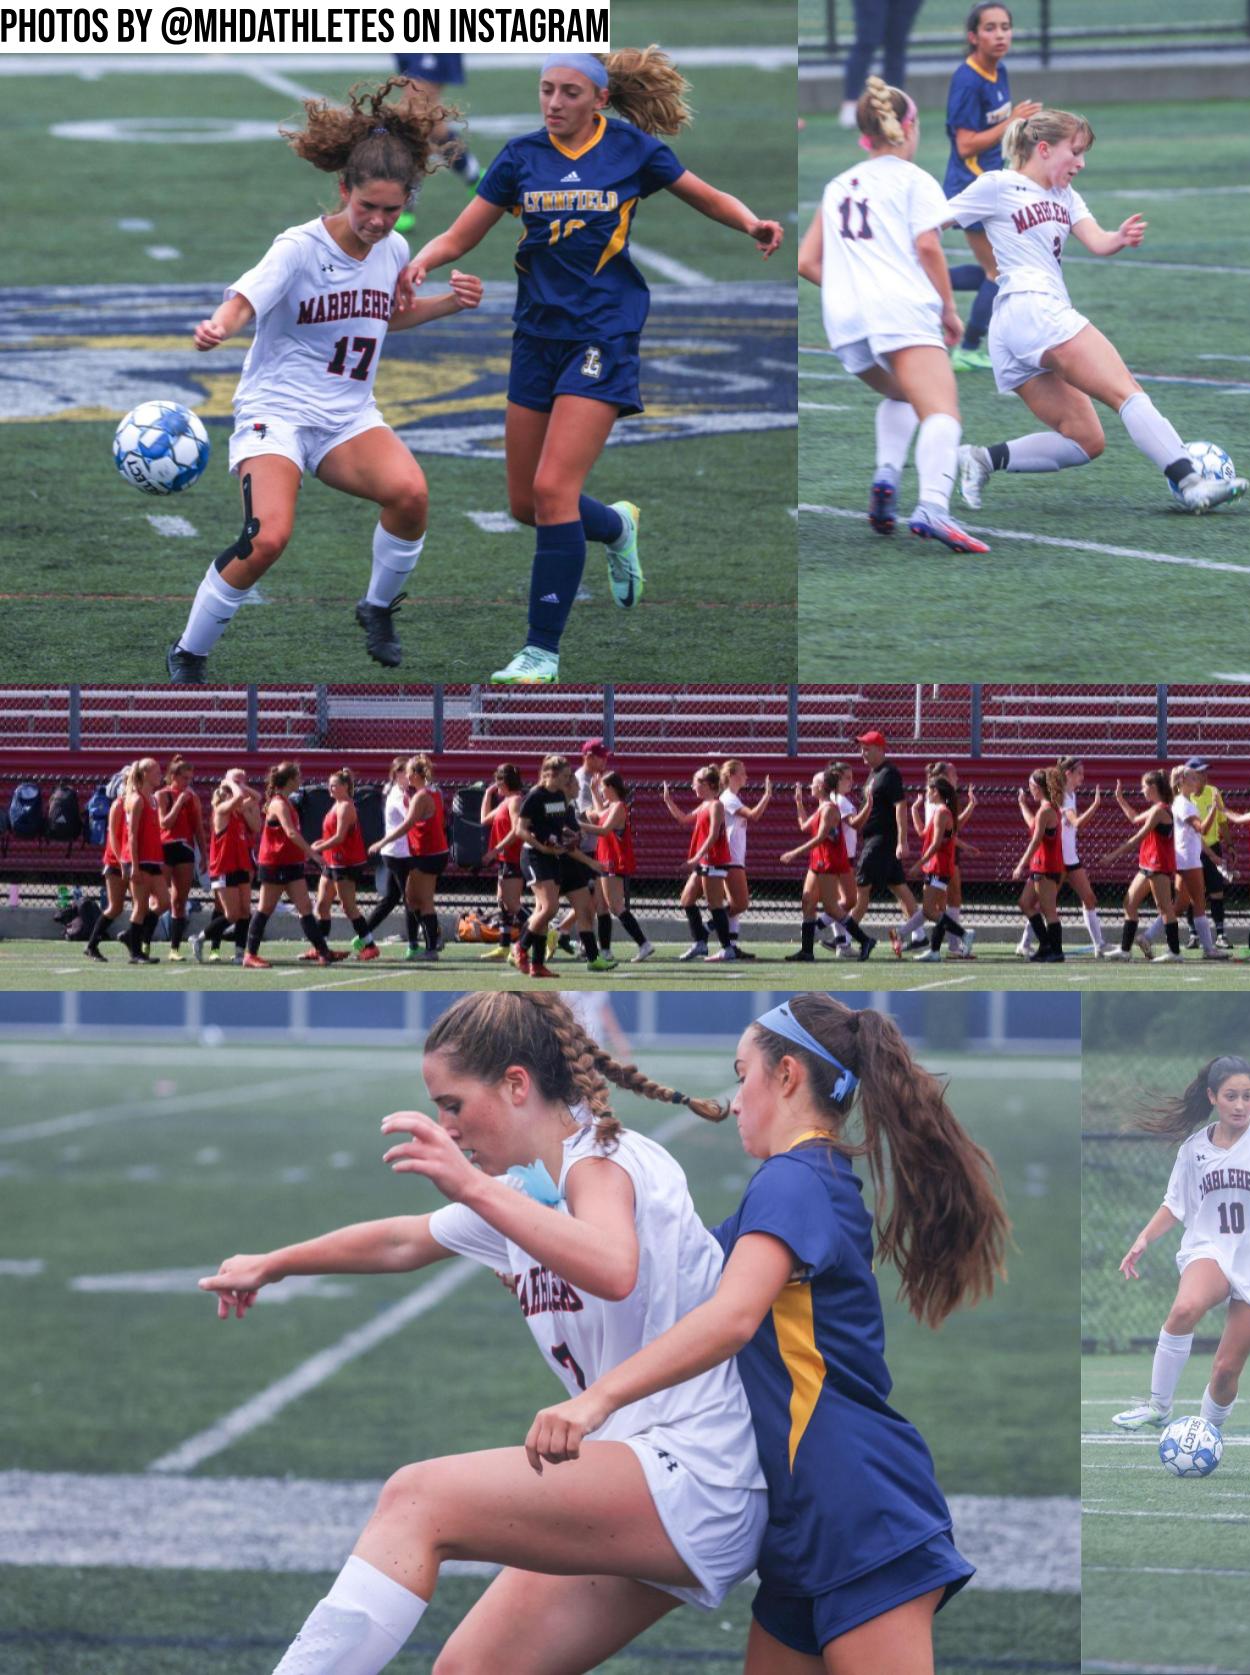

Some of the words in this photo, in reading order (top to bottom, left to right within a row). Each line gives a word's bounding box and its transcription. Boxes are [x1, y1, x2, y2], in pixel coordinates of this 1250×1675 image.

[524, 190, 618, 212] LYNNFIELD
[297, 289, 394, 324] MARBLEHE
[327, 336, 377, 381] 17
[1217, 1202, 1245, 1234] 10
[1184, 1419, 1201, 1450] SELECT
